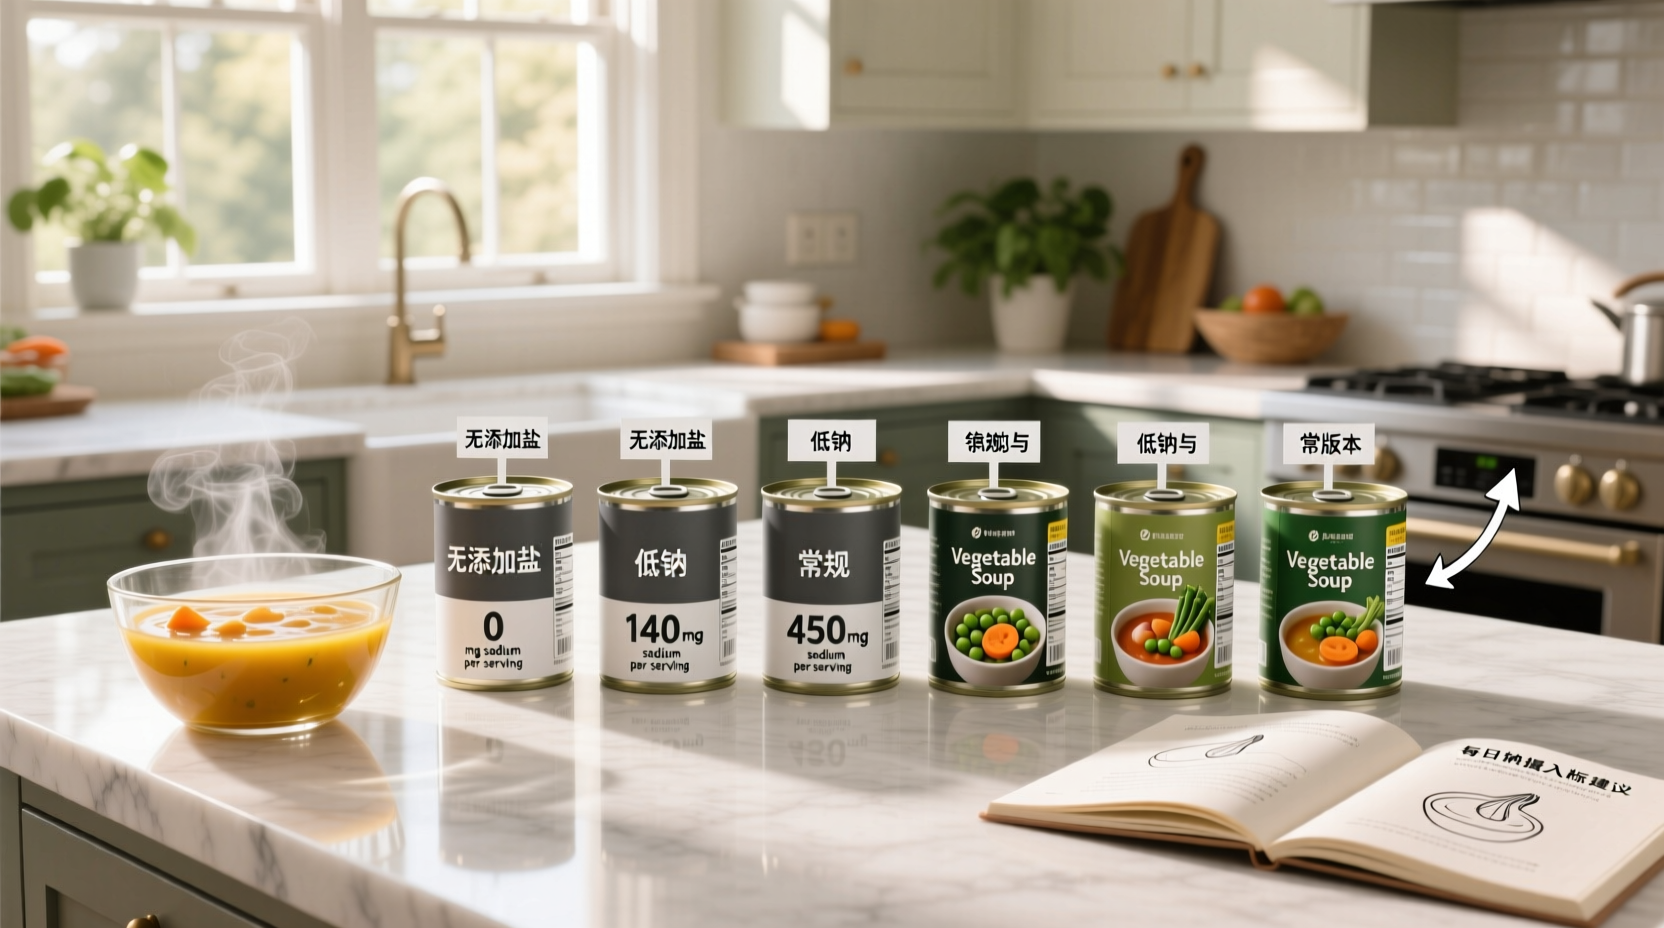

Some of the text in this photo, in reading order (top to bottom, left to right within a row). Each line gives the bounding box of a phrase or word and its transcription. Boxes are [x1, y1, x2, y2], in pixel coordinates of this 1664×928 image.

[465, 428, 541, 450] 无添加盐
[629, 429, 706, 451] 无添加盐
[811, 430, 852, 452] 低钠
[447, 545, 541, 575] 无添加盐
[634, 548, 687, 578] 低钠
[799, 548, 850, 578] 常规
[951, 547, 1036, 569] Vegetable
[1119, 549, 1204, 573] Vegetable
[1286, 550, 1375, 575] Vegetable
[971, 565, 1015, 591] Soup
[1139, 571, 1183, 592] Soup
[1308, 573, 1353, 593] Soup
[483, 611, 504, 642] 0
[793, 662, 811, 674] per
